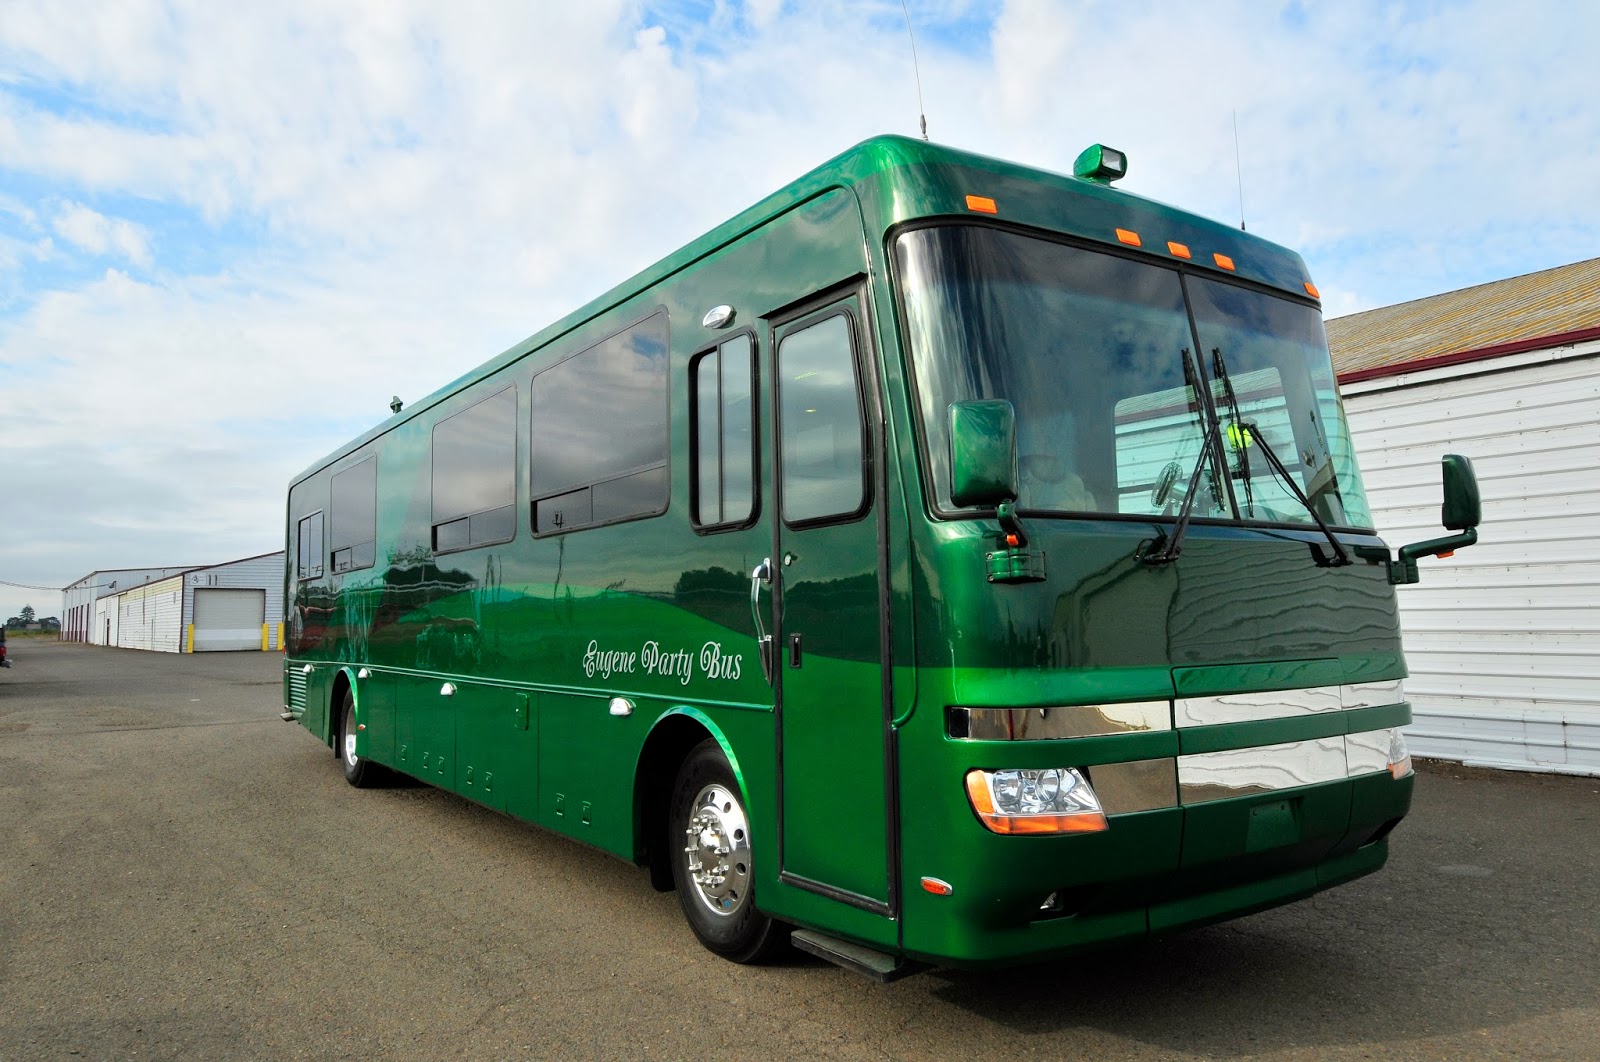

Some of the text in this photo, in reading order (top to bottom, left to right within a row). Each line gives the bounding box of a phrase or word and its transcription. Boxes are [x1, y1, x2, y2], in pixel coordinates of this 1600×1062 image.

[582, 639, 742, 686] Eugene Party Bus
